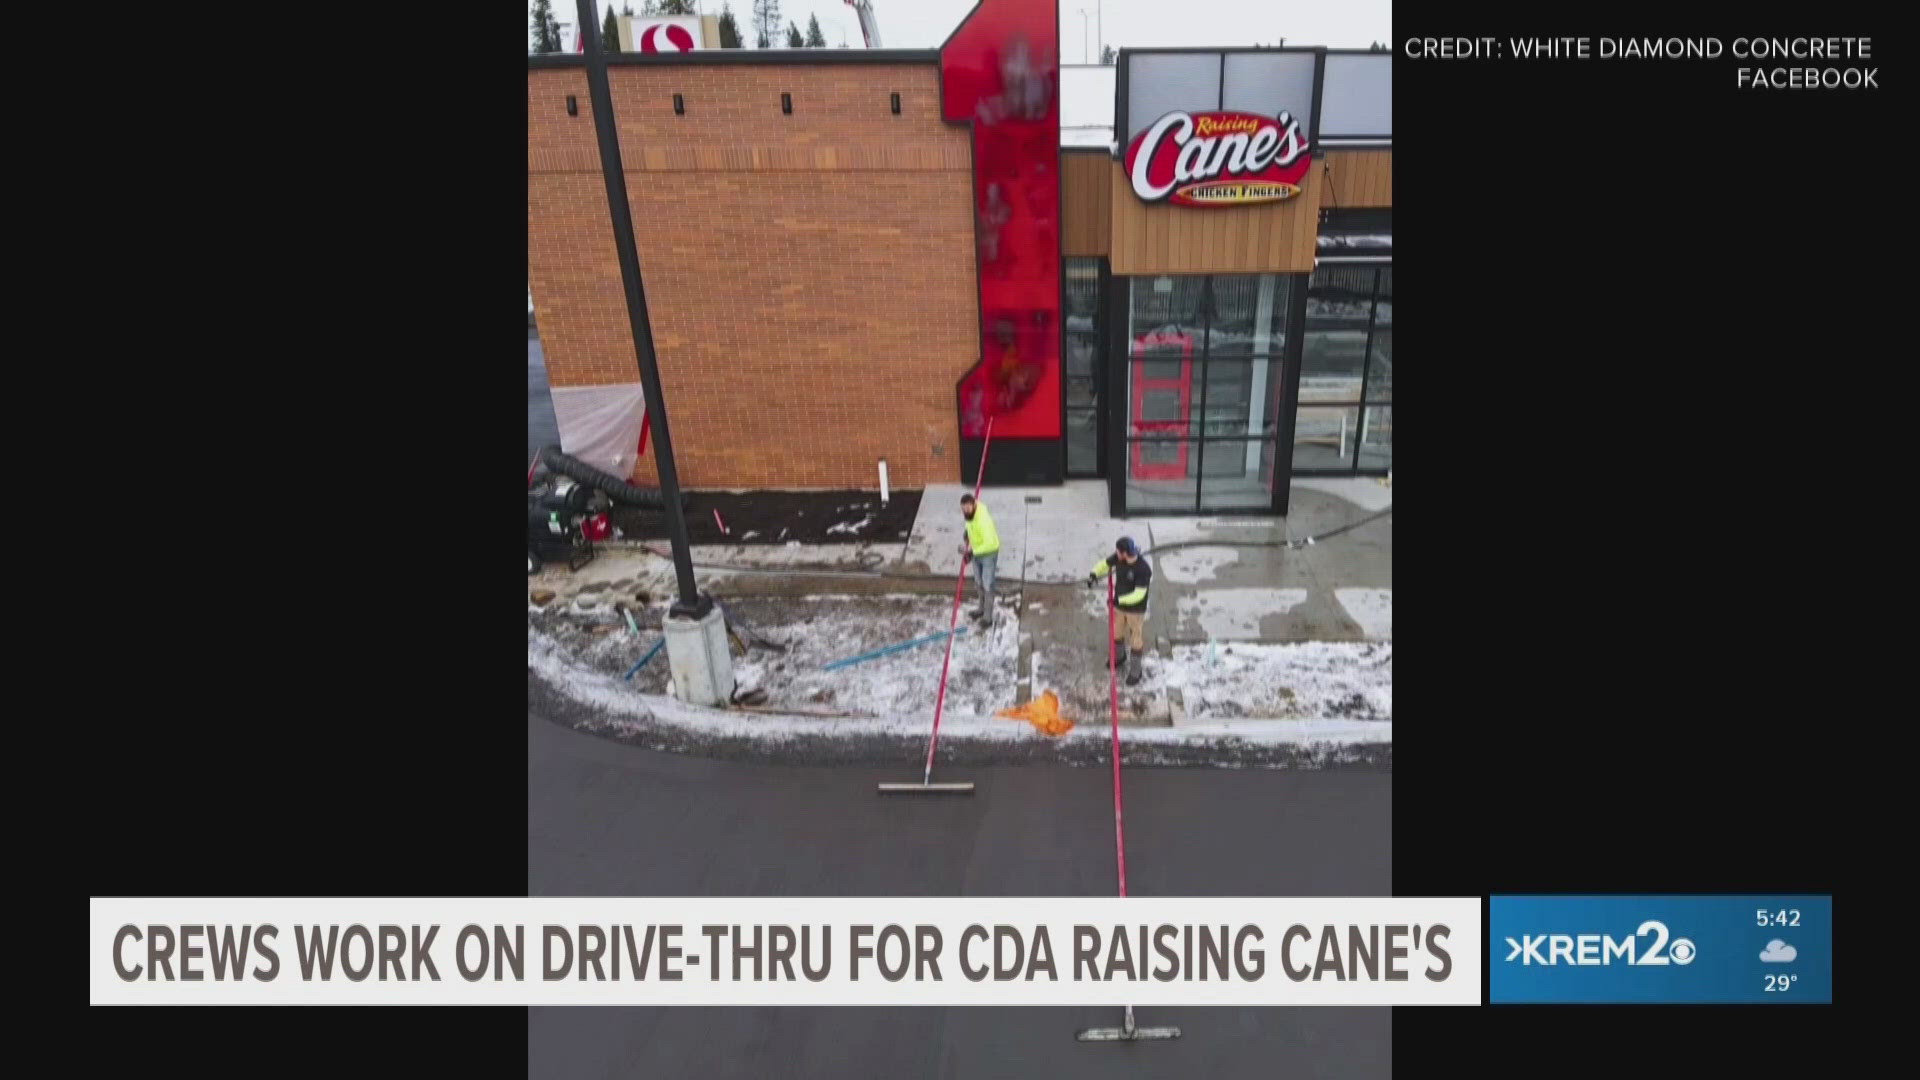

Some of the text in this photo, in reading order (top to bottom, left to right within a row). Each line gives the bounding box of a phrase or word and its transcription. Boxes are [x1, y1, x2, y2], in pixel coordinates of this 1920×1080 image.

[1196, 114, 1259, 135] Raising
[1131, 111, 1309, 200] Cane's
[1190, 186, 1238, 198] CHICKEN
